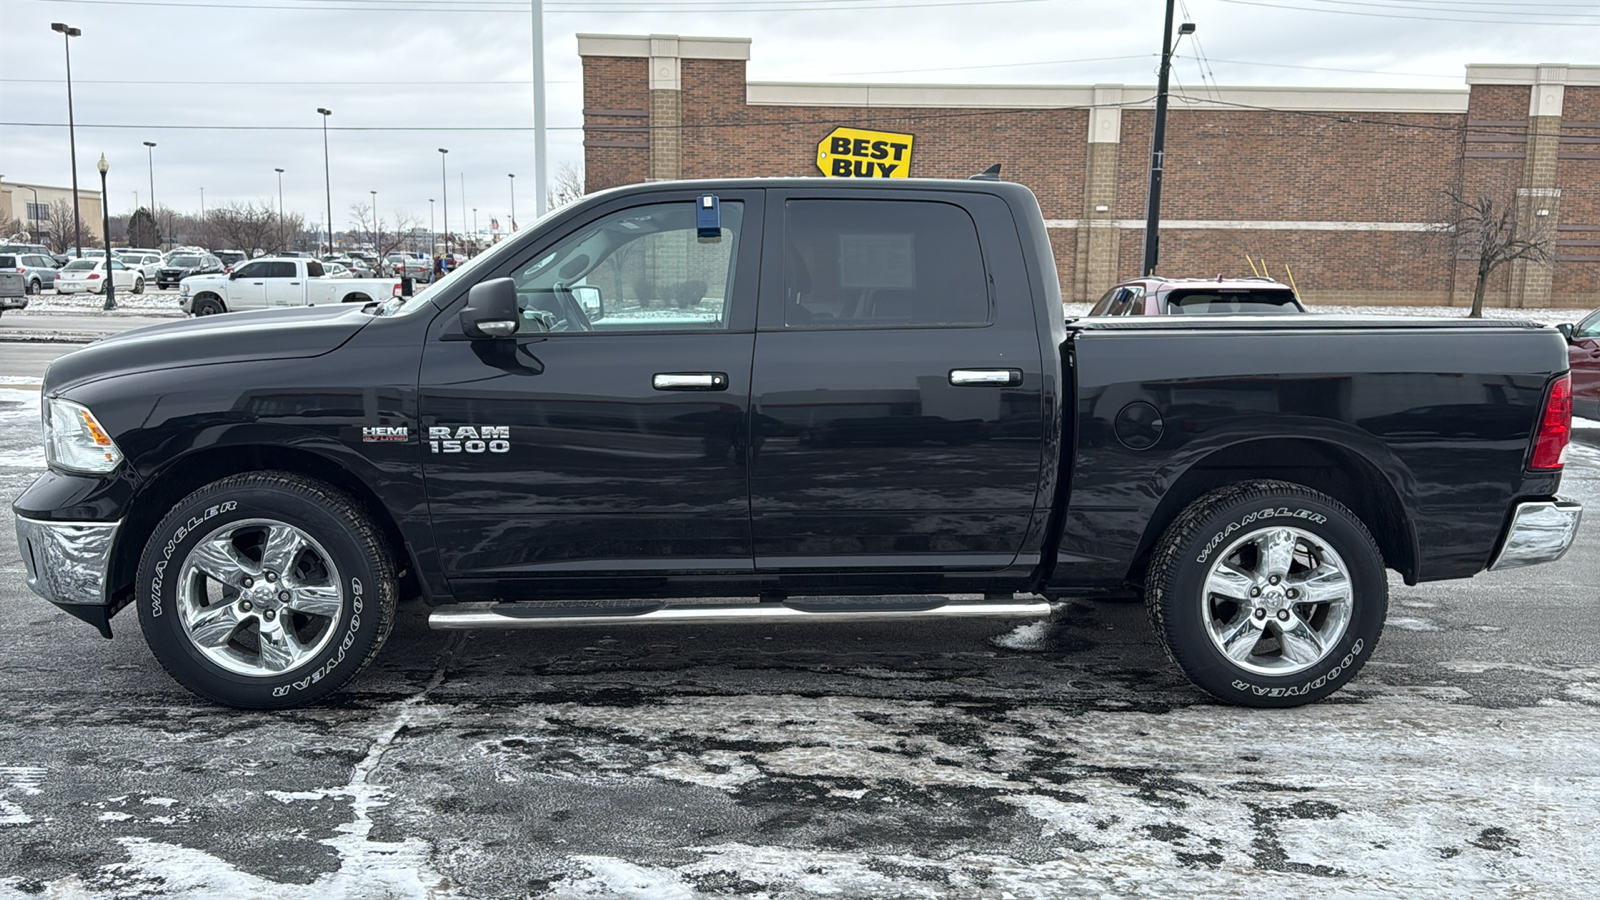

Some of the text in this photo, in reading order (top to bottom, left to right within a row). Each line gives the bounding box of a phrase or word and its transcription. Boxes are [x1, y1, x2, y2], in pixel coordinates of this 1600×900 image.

[830, 136, 908, 161] BEST
[831, 158, 900, 178] BUY
[362, 426, 408, 436] HEMI
[428, 426, 510, 439] RAM
[429, 440, 511, 454] 1500
[1196, 507, 1328, 564] WRANGLER
[151, 500, 238, 617] WRANGLER
[272, 577, 364, 697] GOODYEAR
[1232, 638, 1364, 698] GOODYEAR
